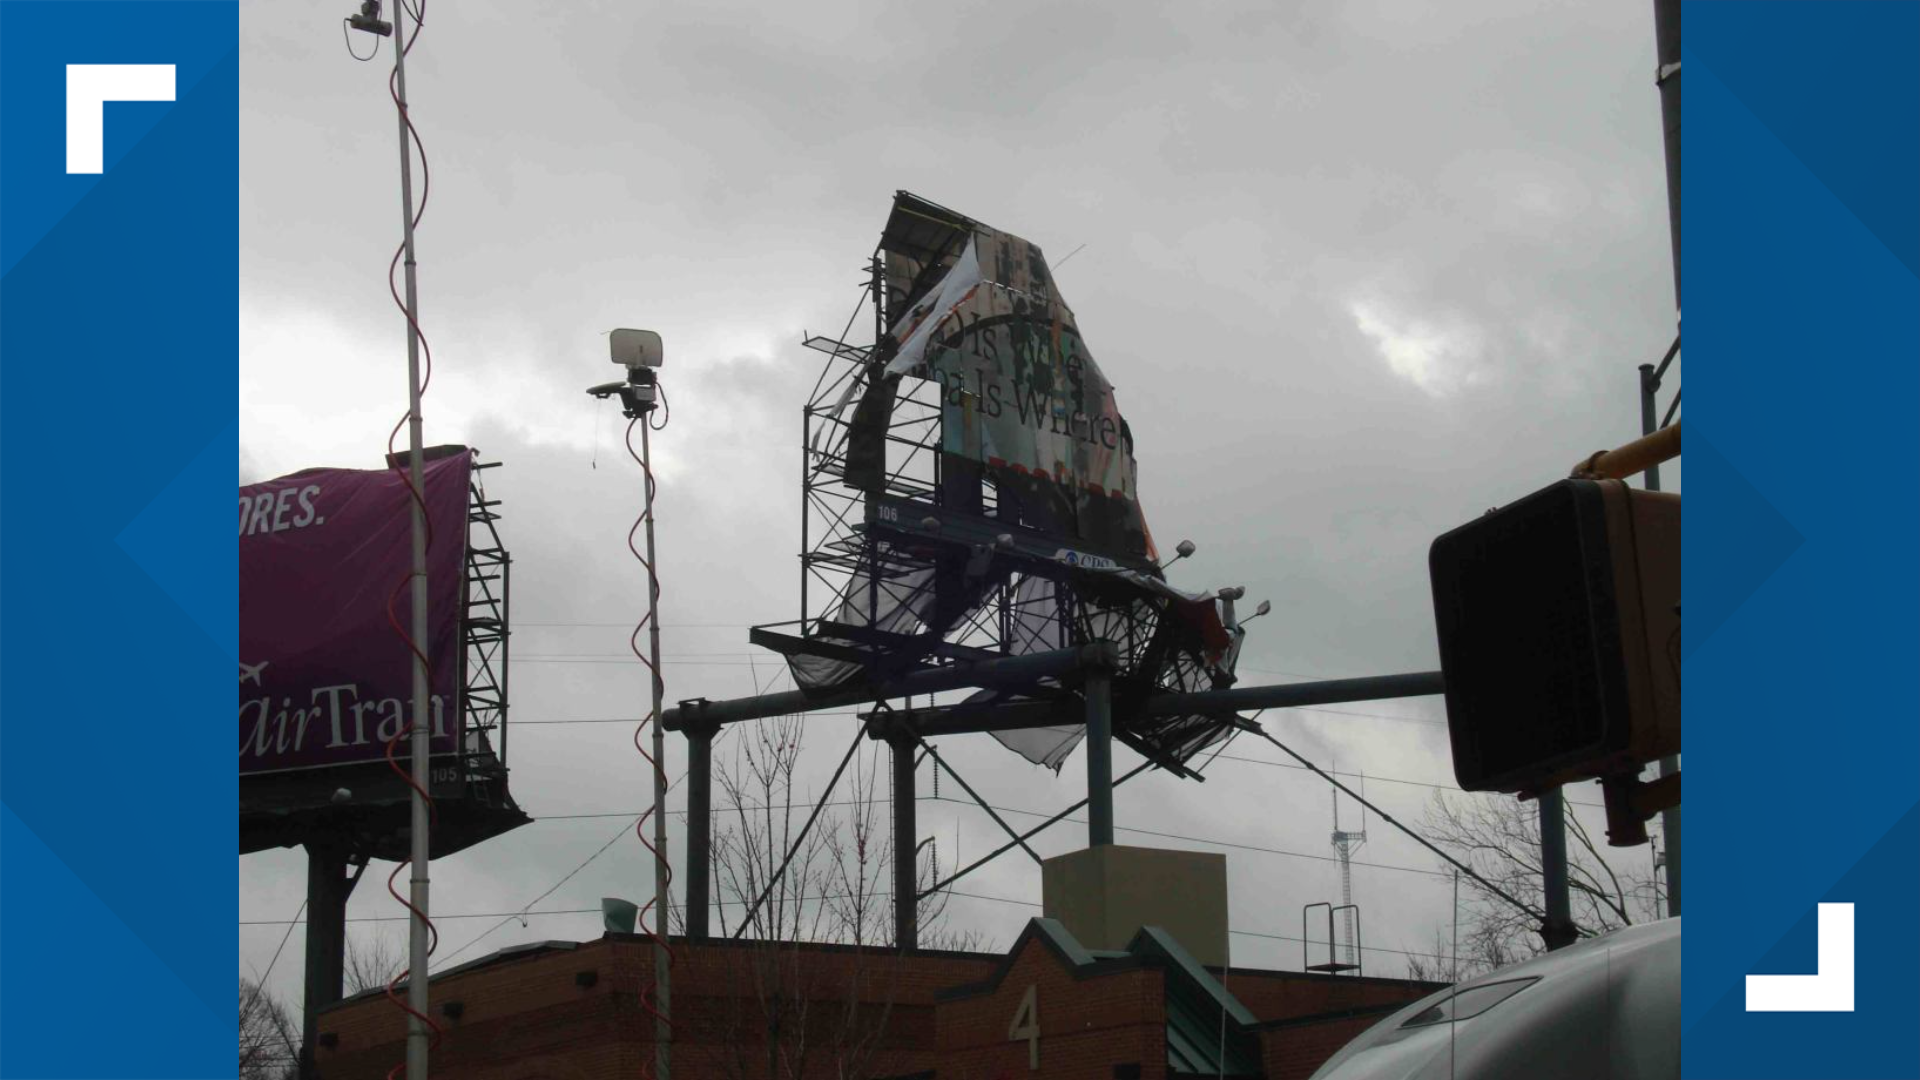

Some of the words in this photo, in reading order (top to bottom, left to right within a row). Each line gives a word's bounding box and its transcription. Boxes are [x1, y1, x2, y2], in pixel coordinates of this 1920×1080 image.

[975, 368, 1002, 418] Is
[878, 506, 898, 522] 106
[432, 767, 457, 784] 105
[1009, 984, 1041, 1070] 4
